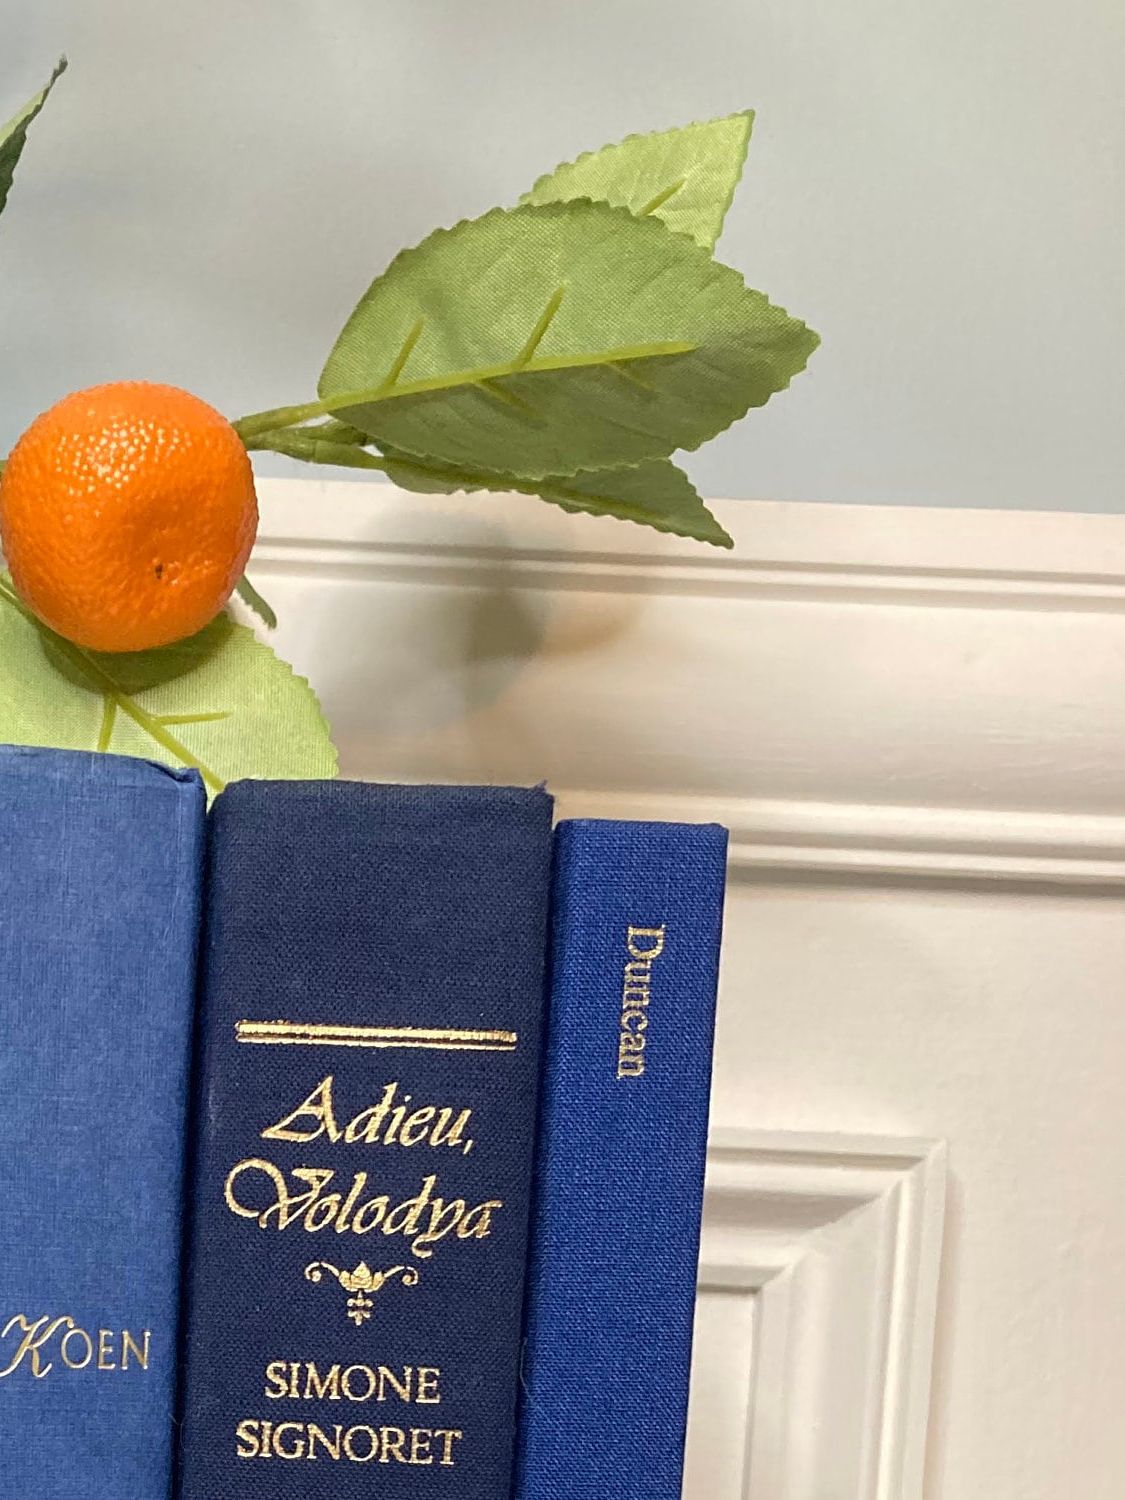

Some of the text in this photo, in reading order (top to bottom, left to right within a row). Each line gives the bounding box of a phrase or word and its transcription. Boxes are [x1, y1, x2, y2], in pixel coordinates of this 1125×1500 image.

[617, 923, 666, 1080] Duncan
[261, 1075, 475, 1155] Adieu,
[224, 1157, 503, 1259] Volodya
[264, 1360, 442, 1404] SIMONE
[236, 1419, 464, 1467] SIGNORET
